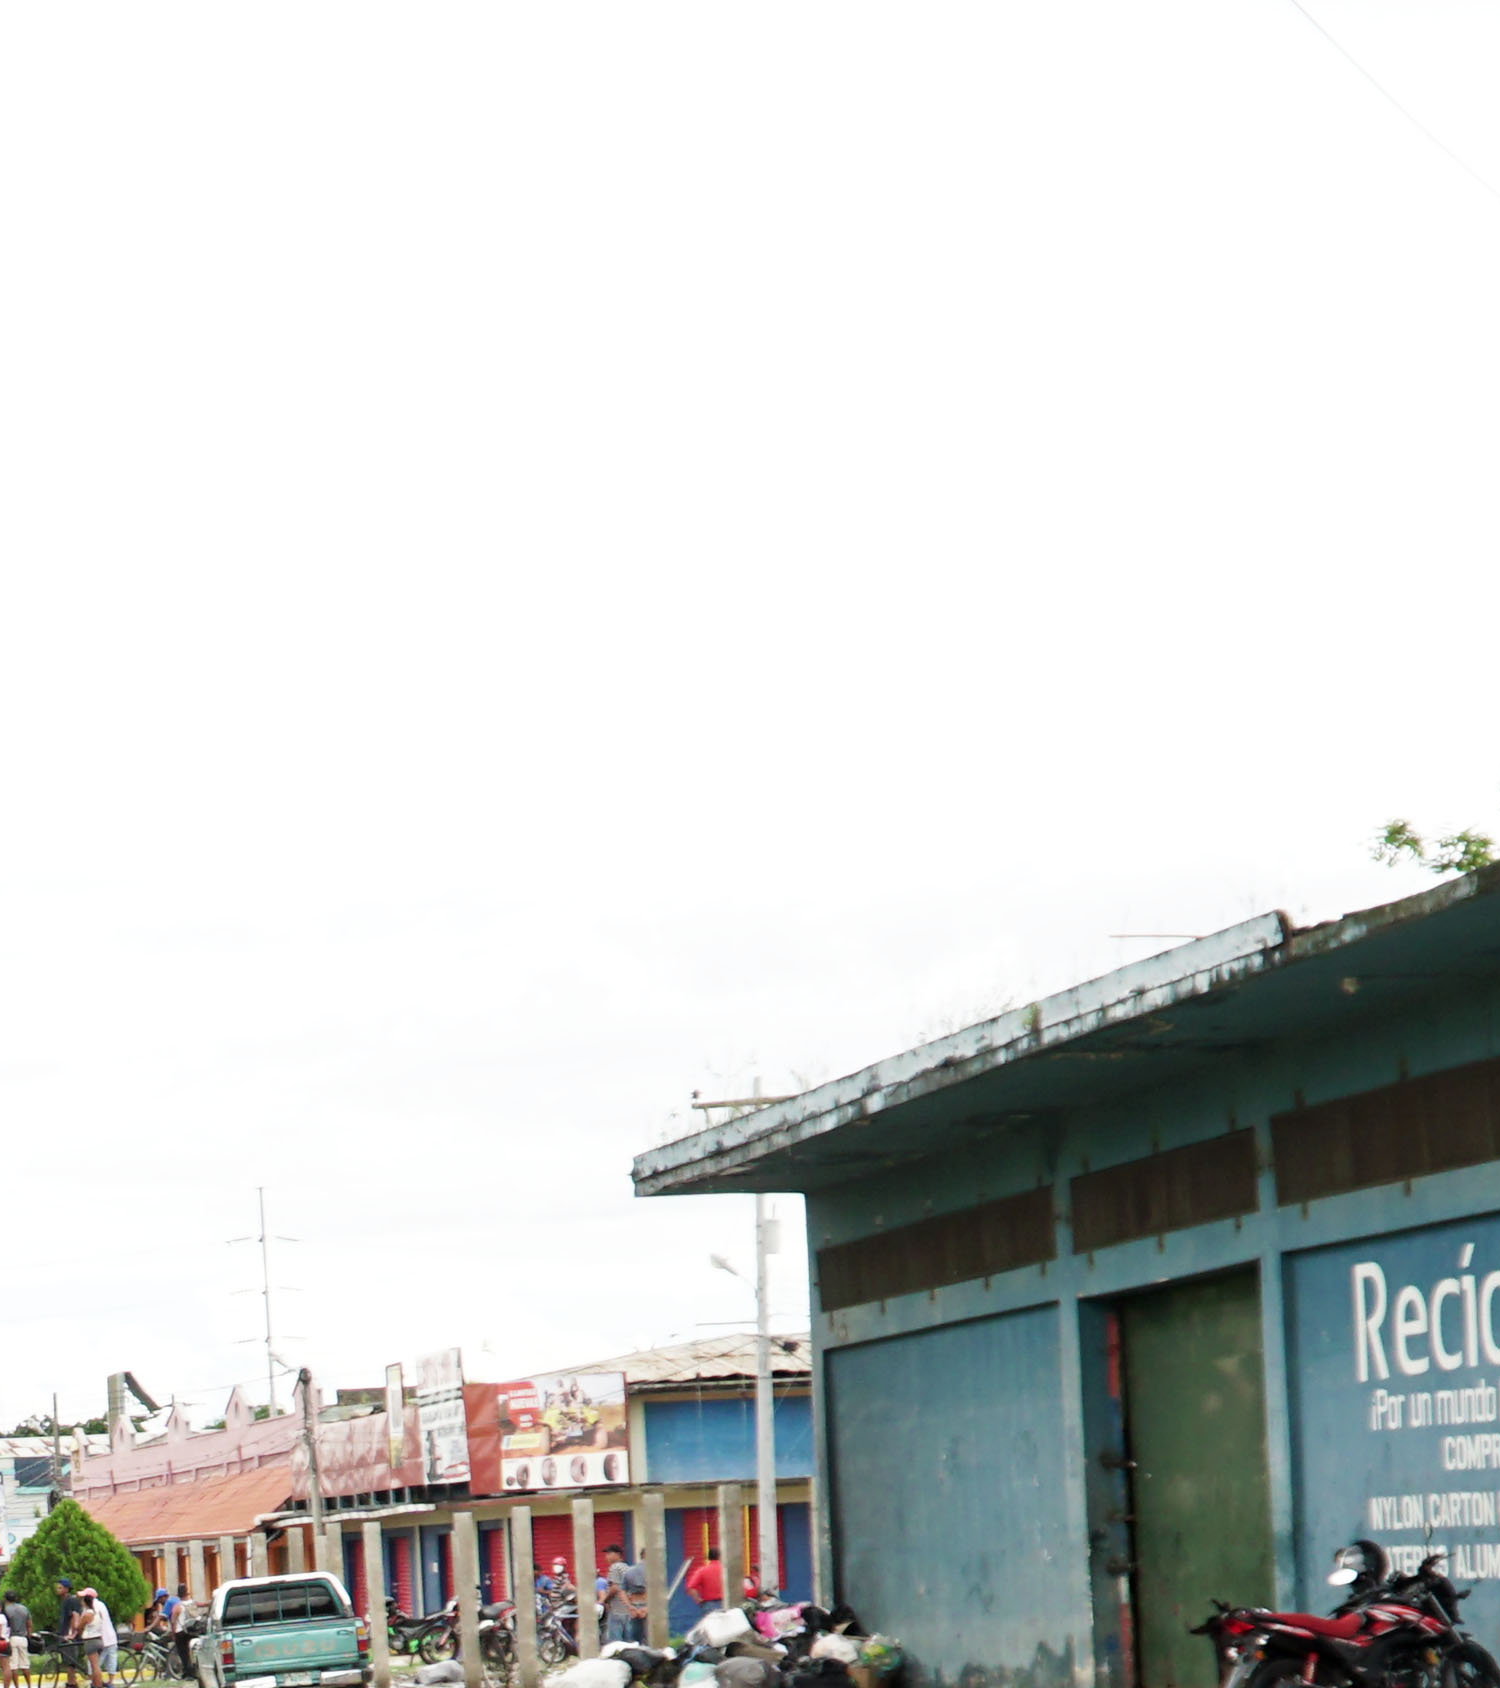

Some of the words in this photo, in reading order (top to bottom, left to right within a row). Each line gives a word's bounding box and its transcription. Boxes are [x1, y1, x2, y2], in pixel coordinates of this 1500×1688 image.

[1408, 1392, 1433, 1428] un
[1434, 1379, 1497, 1425] mundo
[1368, 1494, 1424, 1530] NYLON
[1427, 1492, 1496, 1528] CARTON
